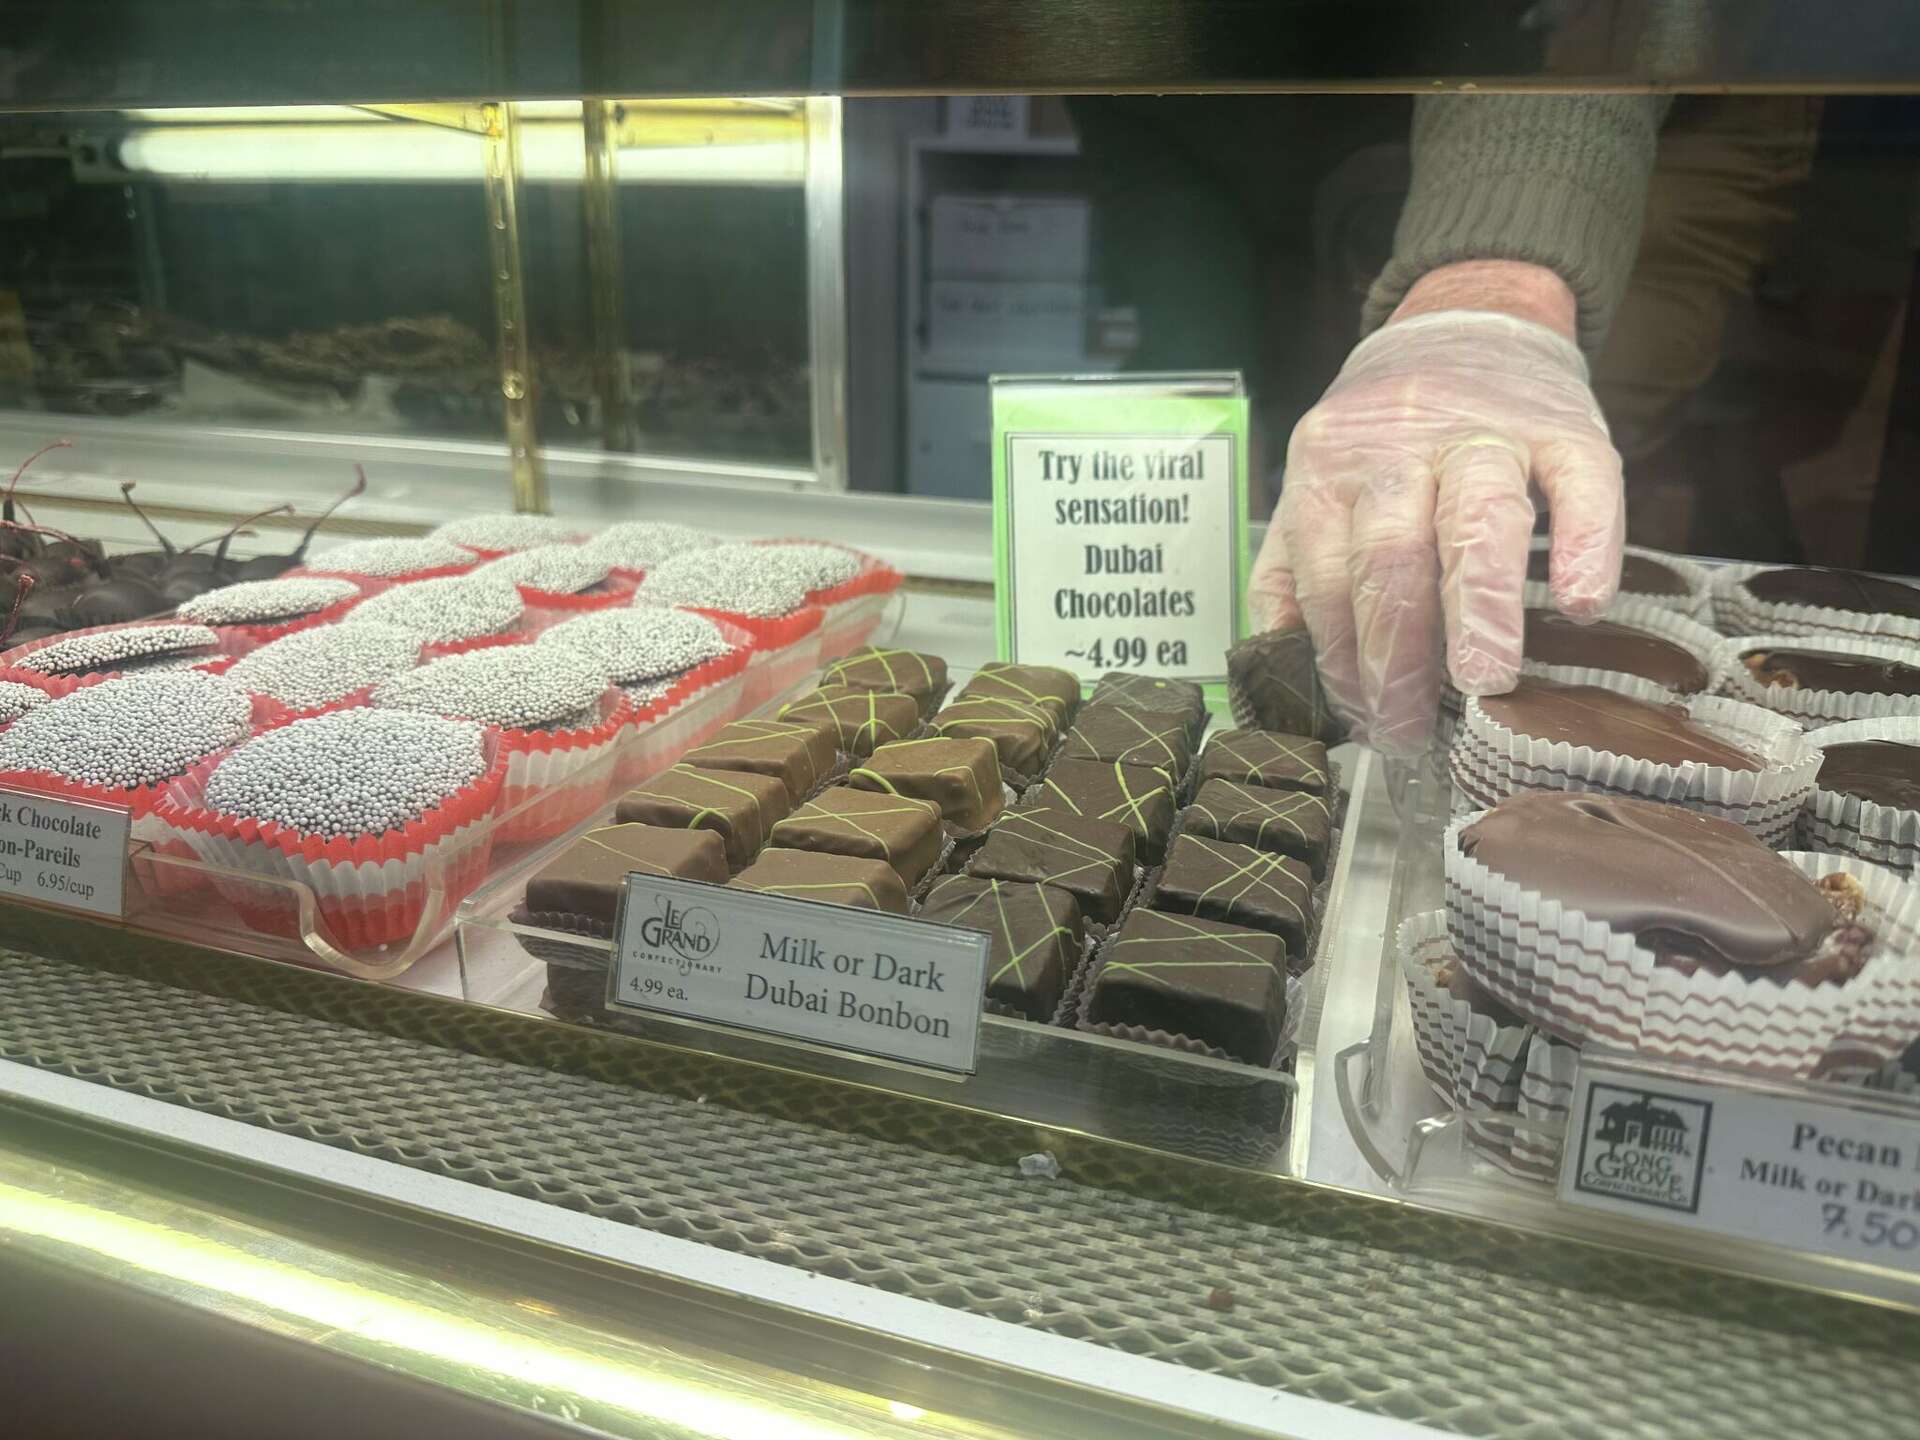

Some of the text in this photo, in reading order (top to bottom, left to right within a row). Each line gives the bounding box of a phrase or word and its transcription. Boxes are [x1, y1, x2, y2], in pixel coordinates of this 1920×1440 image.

[1039, 449, 1204, 484] Try the viral
[1055, 493, 1190, 525] sensation!
[1084, 543, 1163, 575] Dubai
[1054, 586, 1195, 619] Chocolates
[1156, 638, 1188, 667] ea
[0, 803, 102, 840] k Chocolate
[37, 871, 95, 900] 6.95/cup
[665, 900, 682, 930] LE
[641, 917, 711, 953] GRAND
[759, 932, 945, 992] Milk or Dark
[629, 976, 688, 1001] 4.99 ea.
[744, 973, 951, 1039] Dubai Bonbon
[1792, 1122, 1902, 1169] Pecan
[1740, 1157, 1805, 1191] Milk
[1815, 1176, 1848, 1198] or
[1821, 1202, 1920, 1250] 7.50
